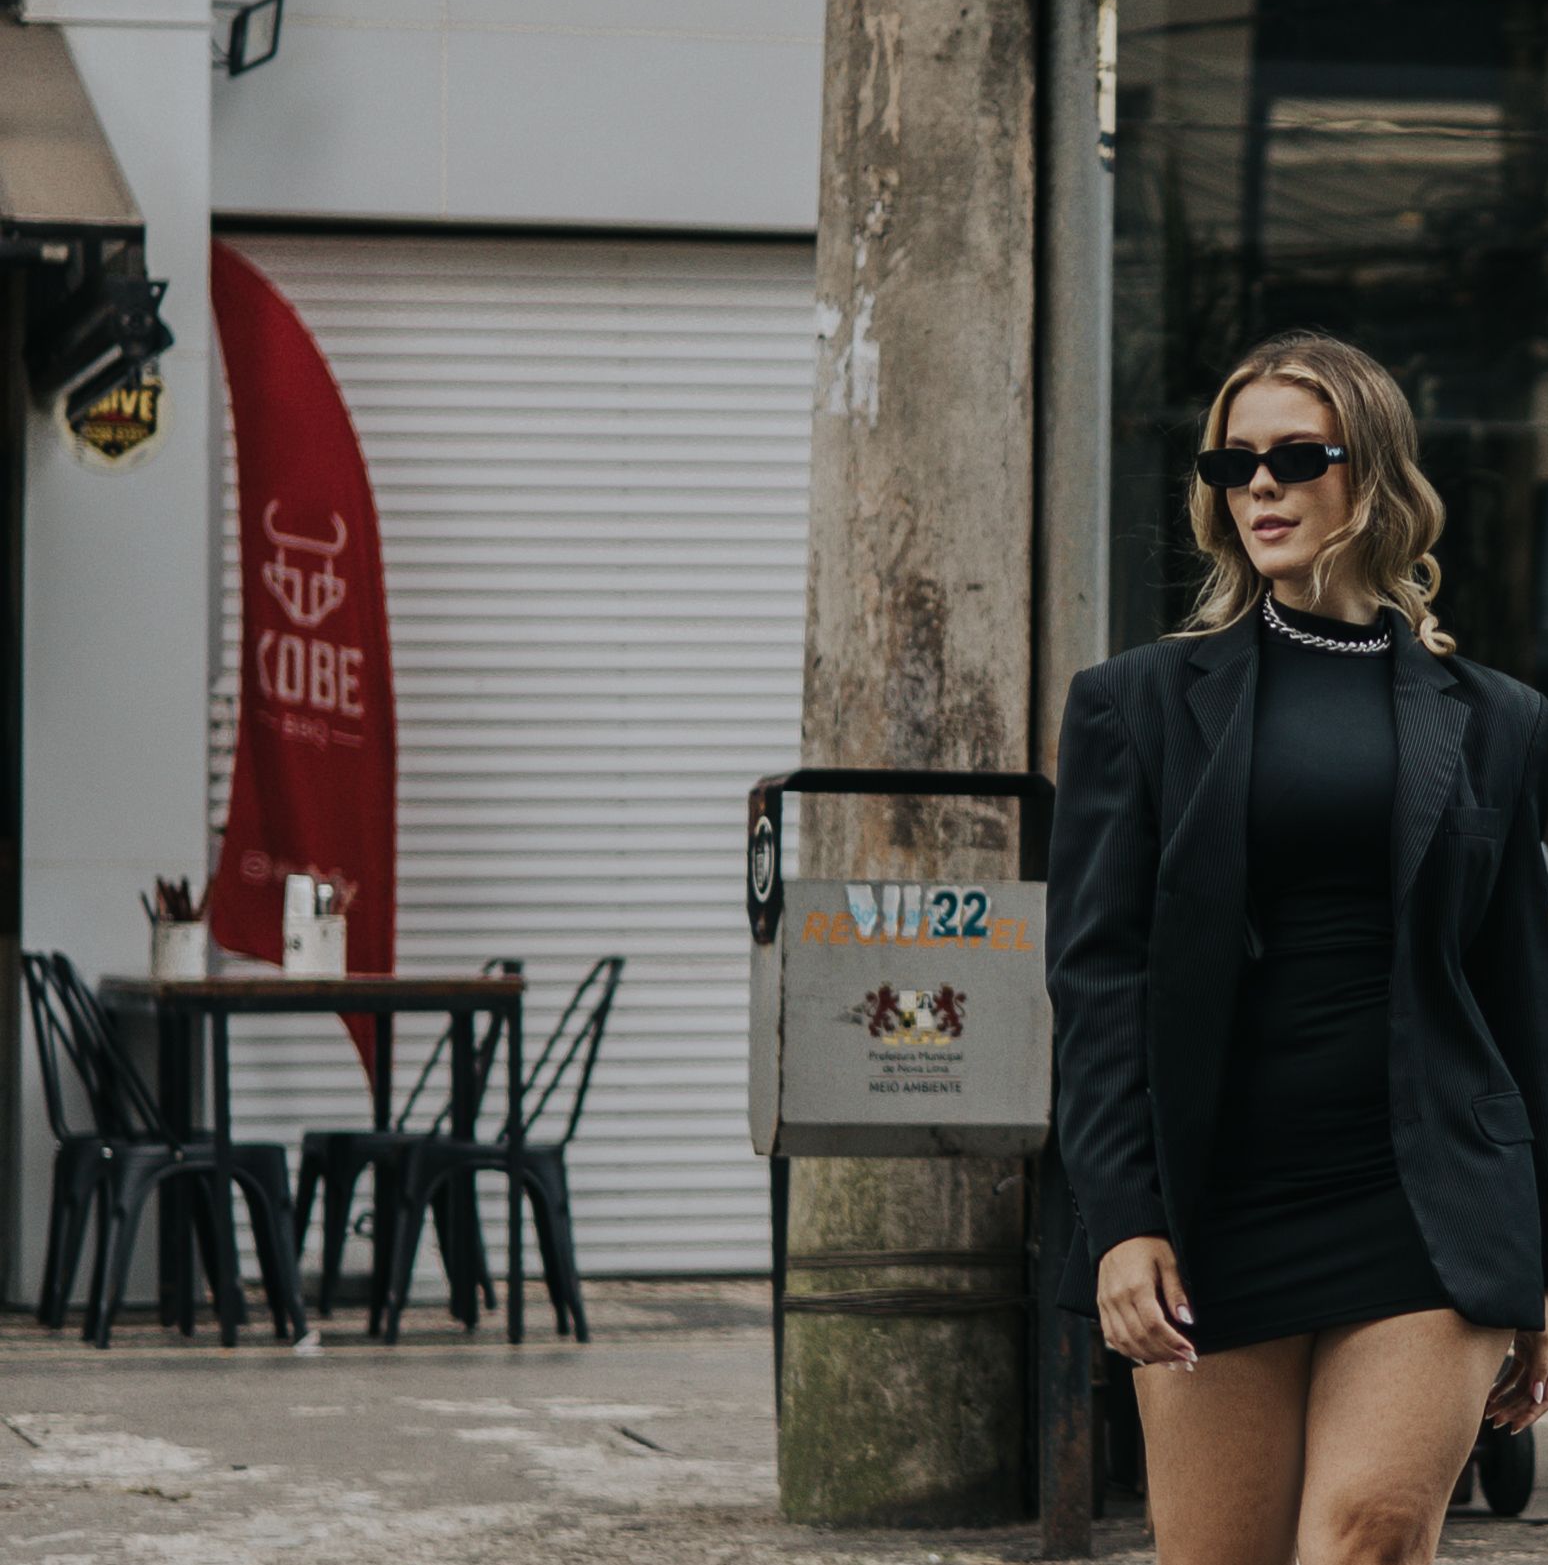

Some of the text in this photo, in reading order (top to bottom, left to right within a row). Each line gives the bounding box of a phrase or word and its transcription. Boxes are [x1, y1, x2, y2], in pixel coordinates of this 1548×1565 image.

[918, 1050, 963, 1063] Municipal
[868, 1080, 963, 1093] MEIO AMBIENTE
